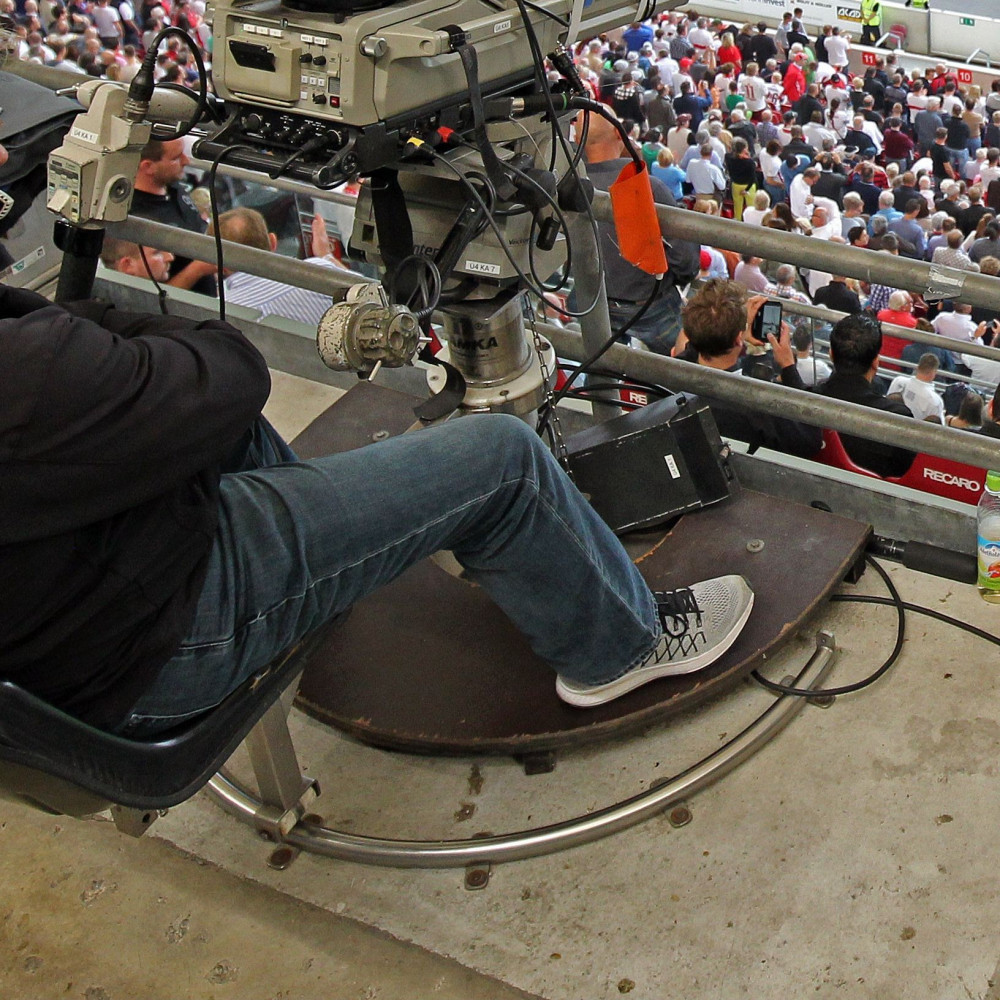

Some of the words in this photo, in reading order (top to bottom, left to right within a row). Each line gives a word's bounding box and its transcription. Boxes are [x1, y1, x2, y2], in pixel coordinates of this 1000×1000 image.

[838, 8, 862, 18] AKAD
[864, 54, 873, 64] 11
[960, 72, 971, 81] 10
[744, 84, 757, 101] 11
[923, 467, 980, 492] RECARO
